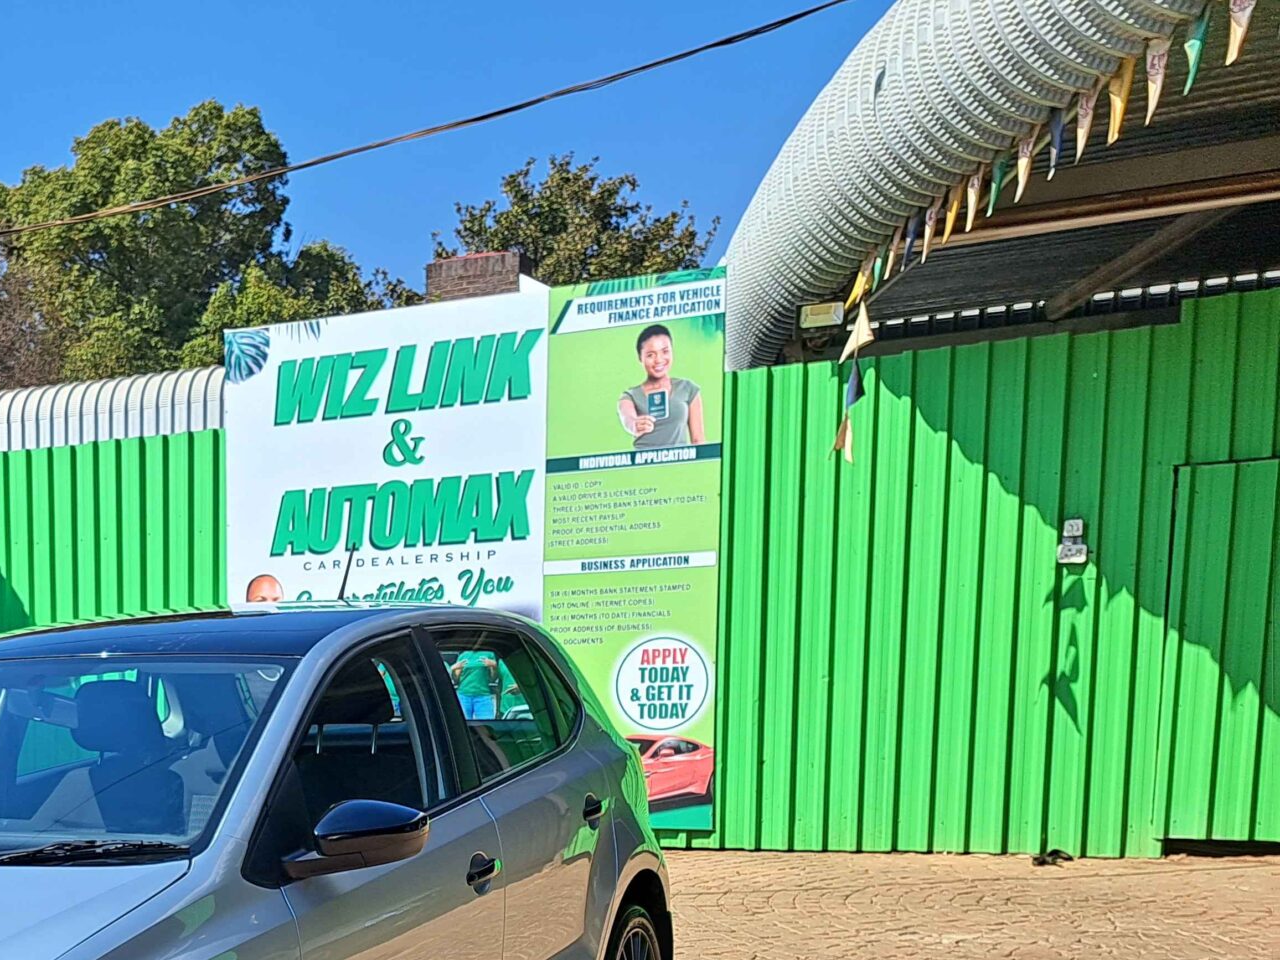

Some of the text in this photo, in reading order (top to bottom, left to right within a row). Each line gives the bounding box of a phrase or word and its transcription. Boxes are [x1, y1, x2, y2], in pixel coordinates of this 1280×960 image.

[577, 285, 721, 315] REQUIREMENTS FOR VEHICLE
[608, 298, 720, 324] FINANCE APPLICATION
[274, 328, 545, 427] WIZ LINK
[382, 419, 425, 468] &
[579, 447, 697, 469] INDIVIDUAL APPLICATION
[553, 482, 571, 490] VALID
[609, 489, 636, 498] LICENSE
[639, 487, 657, 495] COPY
[613, 501, 631, 509] BANK
[633, 497, 672, 507] STATEMENT
[269, 468, 536, 558] AUTOMAX
[572, 515, 597, 523] RECENT
[599, 513, 625, 521] PAYSLIP
[586, 525, 627, 533] RESIDENTIAL
[629, 521, 661, 530] ADDRESS
[303, 549, 498, 571] CAR DEALERSHIP
[581, 555, 689, 571] BUSINESS APPLICATION
[457, 567, 515, 606] You
[571, 588, 597, 596] MONTHS
[619, 585, 657, 594] STATEMENT
[659, 584, 691, 592] STAMPED
[567, 601, 589, 609] ONLINE
[595, 599, 626, 607] INTERNET
[632, 610, 671, 618] FINANCIALS
[563, 637, 603, 645] DOCUMENTS
[640, 647, 688, 665] APPLY
[638, 666, 689, 683] TODAY
[630, 683, 694, 702] & GET IT
[637, 702, 689, 720] TODAY
